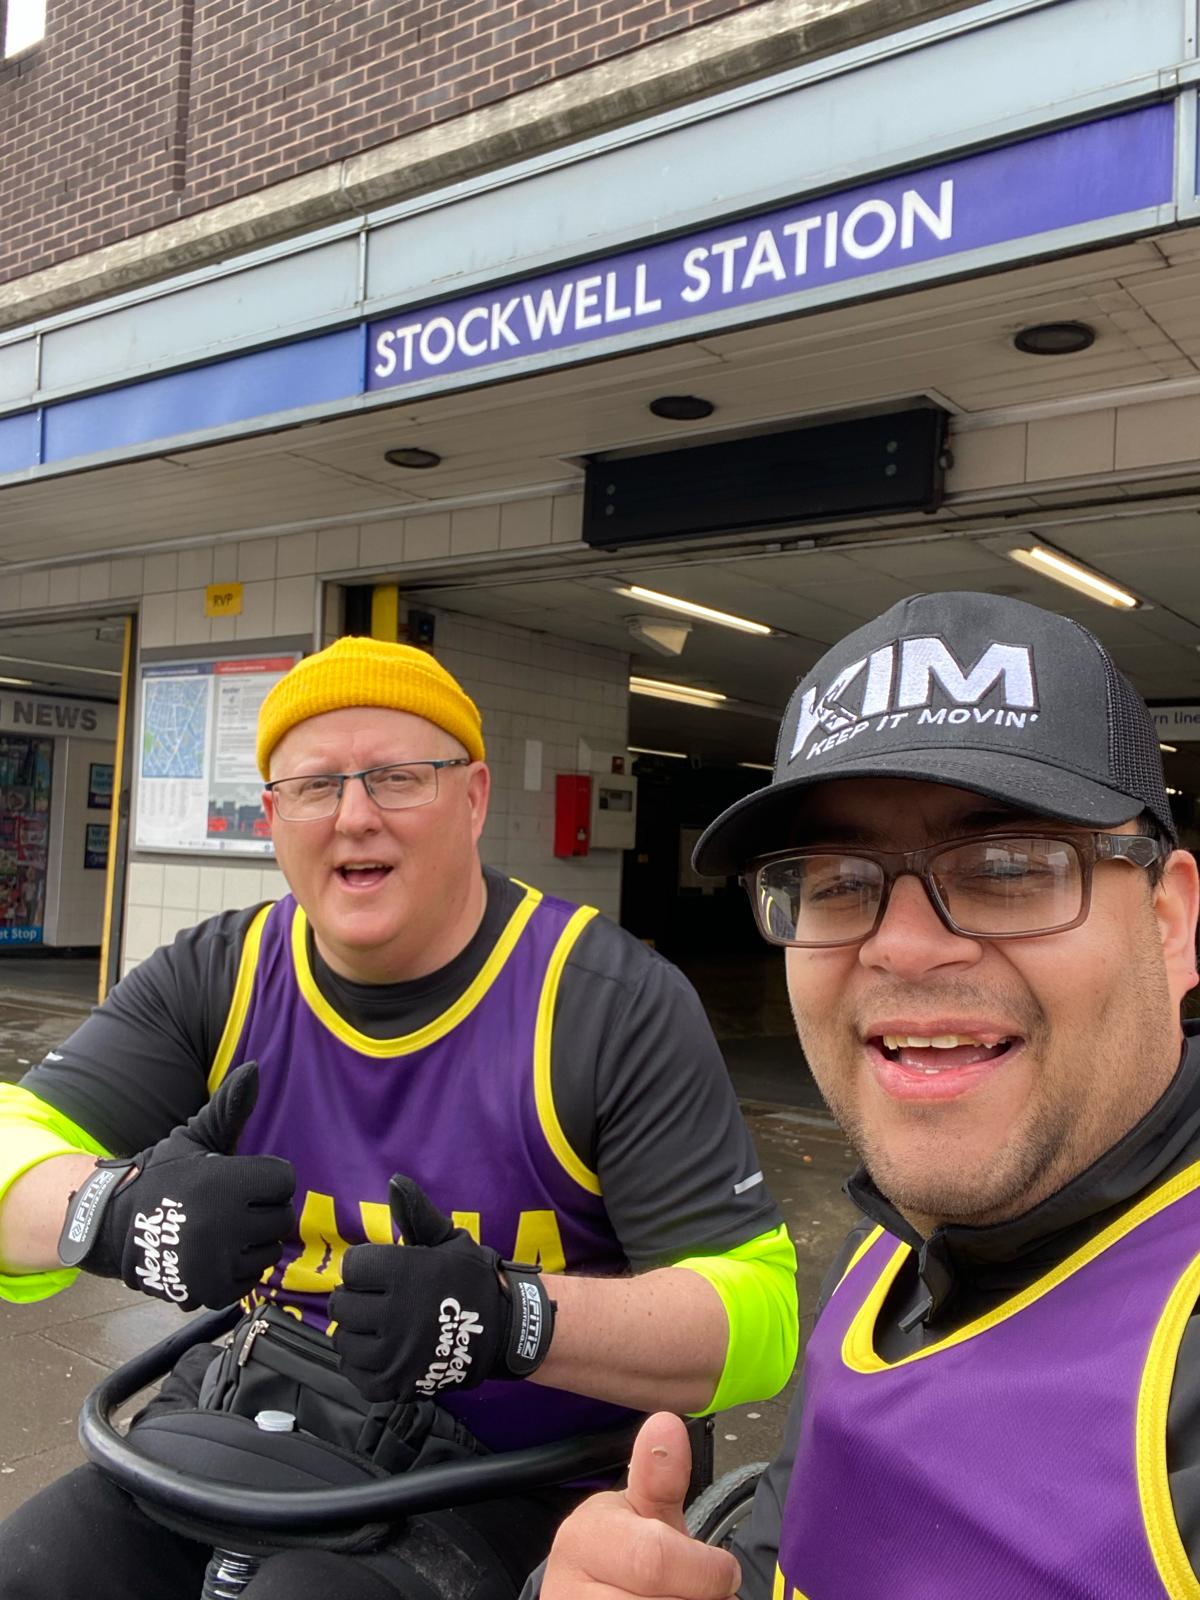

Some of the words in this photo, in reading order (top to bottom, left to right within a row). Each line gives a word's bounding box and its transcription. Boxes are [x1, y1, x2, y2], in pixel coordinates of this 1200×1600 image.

[374, 263, 662, 379] STOCKWELL
[680, 179, 954, 303] STATION
[13, 701, 98, 731] NEWS
[788, 636, 1036, 760] KIM
[805, 721, 870, 760] KEEP
[876, 712, 909, 732] IT
[12, 928, 37, 942] Stop
[161, 1249, 189, 1302] Give
[436, 1297, 461, 1357] Give
